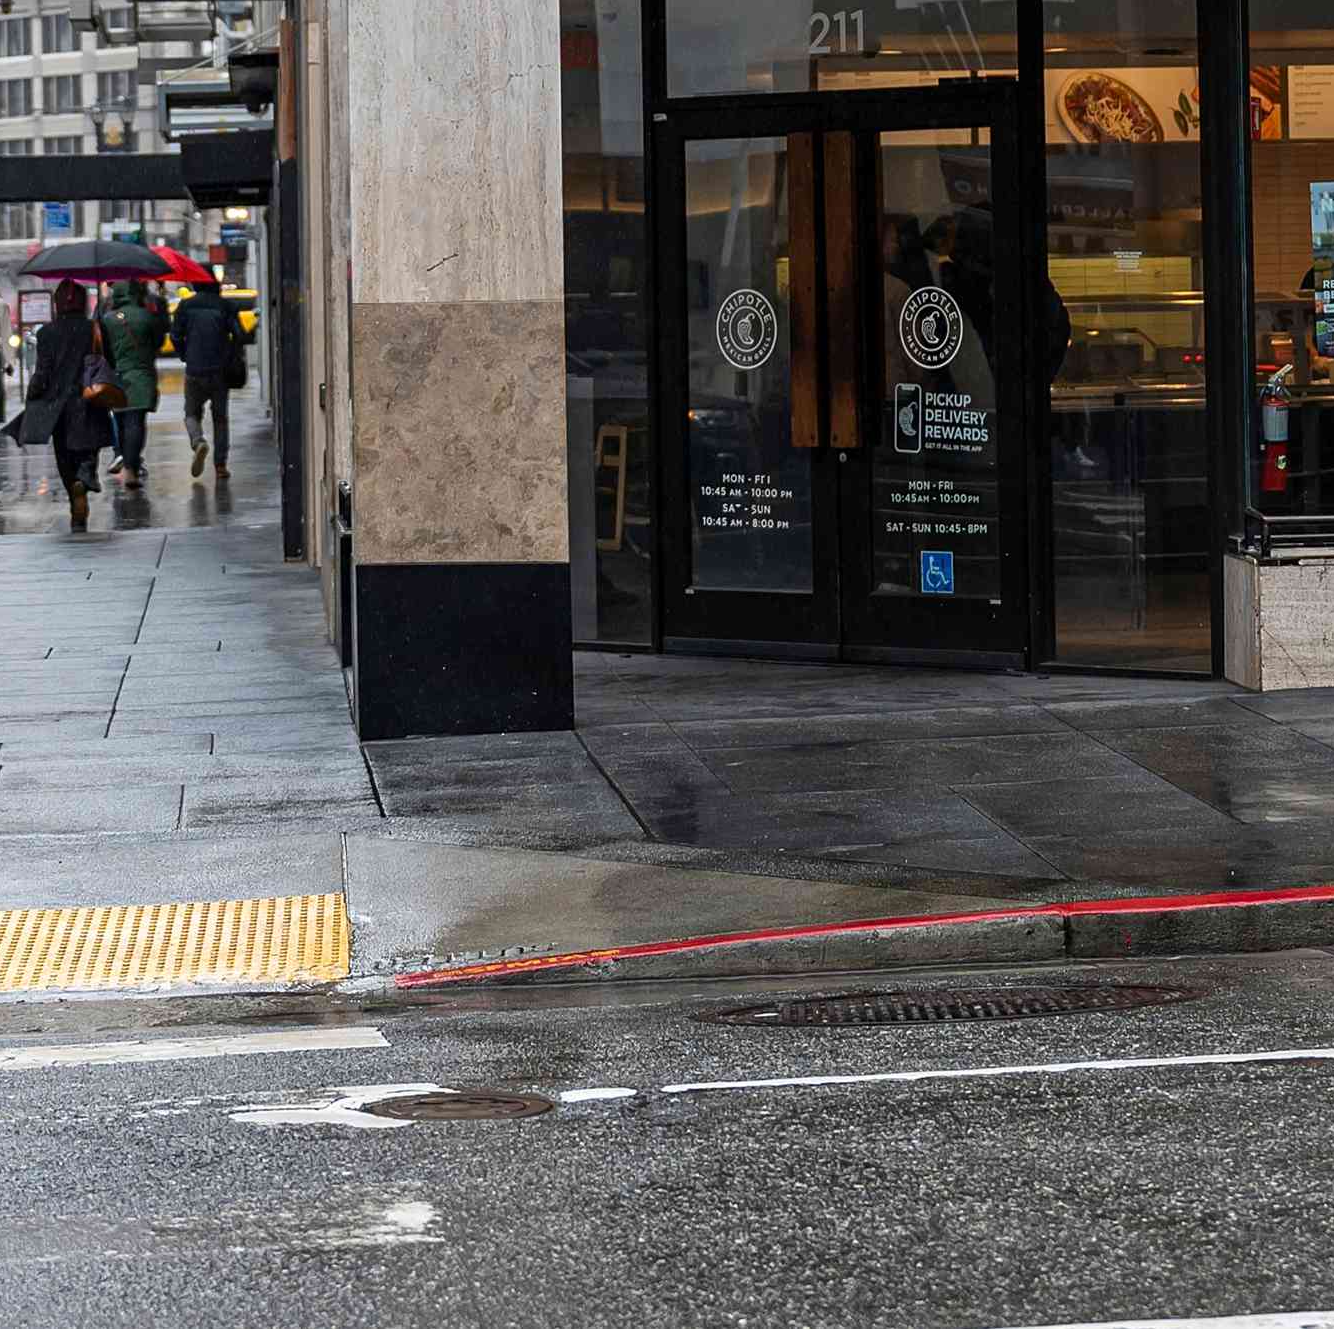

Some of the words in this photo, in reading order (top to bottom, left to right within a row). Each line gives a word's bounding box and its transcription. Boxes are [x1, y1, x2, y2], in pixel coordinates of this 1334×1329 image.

[810, 9, 864, 53] 211
[722, 294, 772, 323] CHIPOTLE
[905, 292, 958, 322] CHIPOTLE
[723, 335, 753, 362] MEXICAN
[907, 335, 938, 362] MEXICAN
[939, 335, 957, 360] GRILL
[925, 391, 972, 407] PICKUP
[925, 408, 987, 425] DELIVERY
[925, 425, 988, 442] REWARDS
[723, 474, 745, 483] MON
[908, 480, 930, 490] MON
[938, 480, 954, 490] FRI
[701, 486, 726, 496] 10:45
[729, 489, 742, 497] AM
[751, 488, 778, 498] 10:00
[780, 490, 793, 499] PM
[751, 504, 771, 515] SUN
[702, 516, 727, 526] 10:45
[730, 519, 743, 527] AM
[752, 518, 774, 528] 8:00
[776, 520, 789, 529] PM
[886, 522, 904, 532] SAT
[912, 522, 931, 533] SUN
